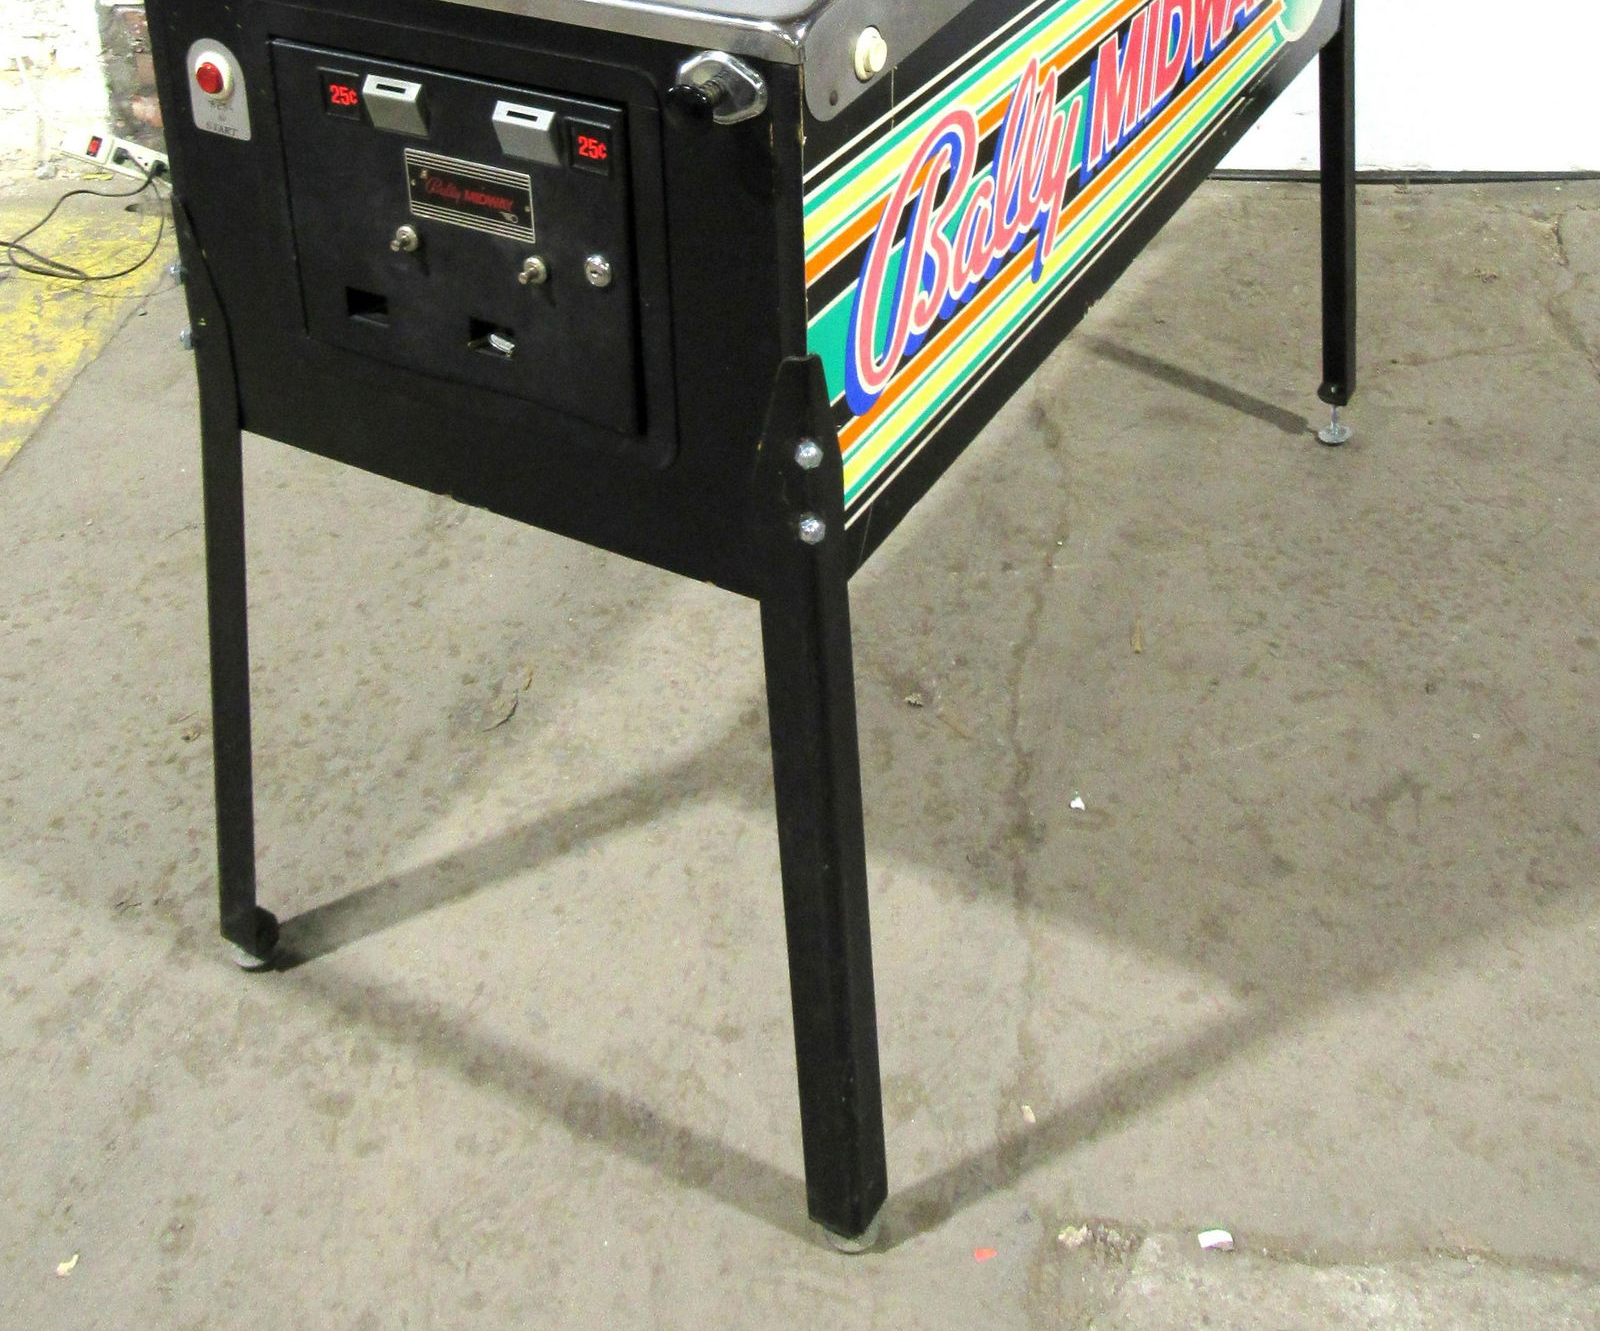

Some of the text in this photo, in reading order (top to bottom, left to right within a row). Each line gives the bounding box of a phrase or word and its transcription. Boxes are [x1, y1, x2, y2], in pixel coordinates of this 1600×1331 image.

[329, 85, 358, 106] 25¢
[577, 133, 608, 160] 25¢
[425, 176, 514, 212] Bally MIDWAY
[850, 52, 1082, 401] Bally
